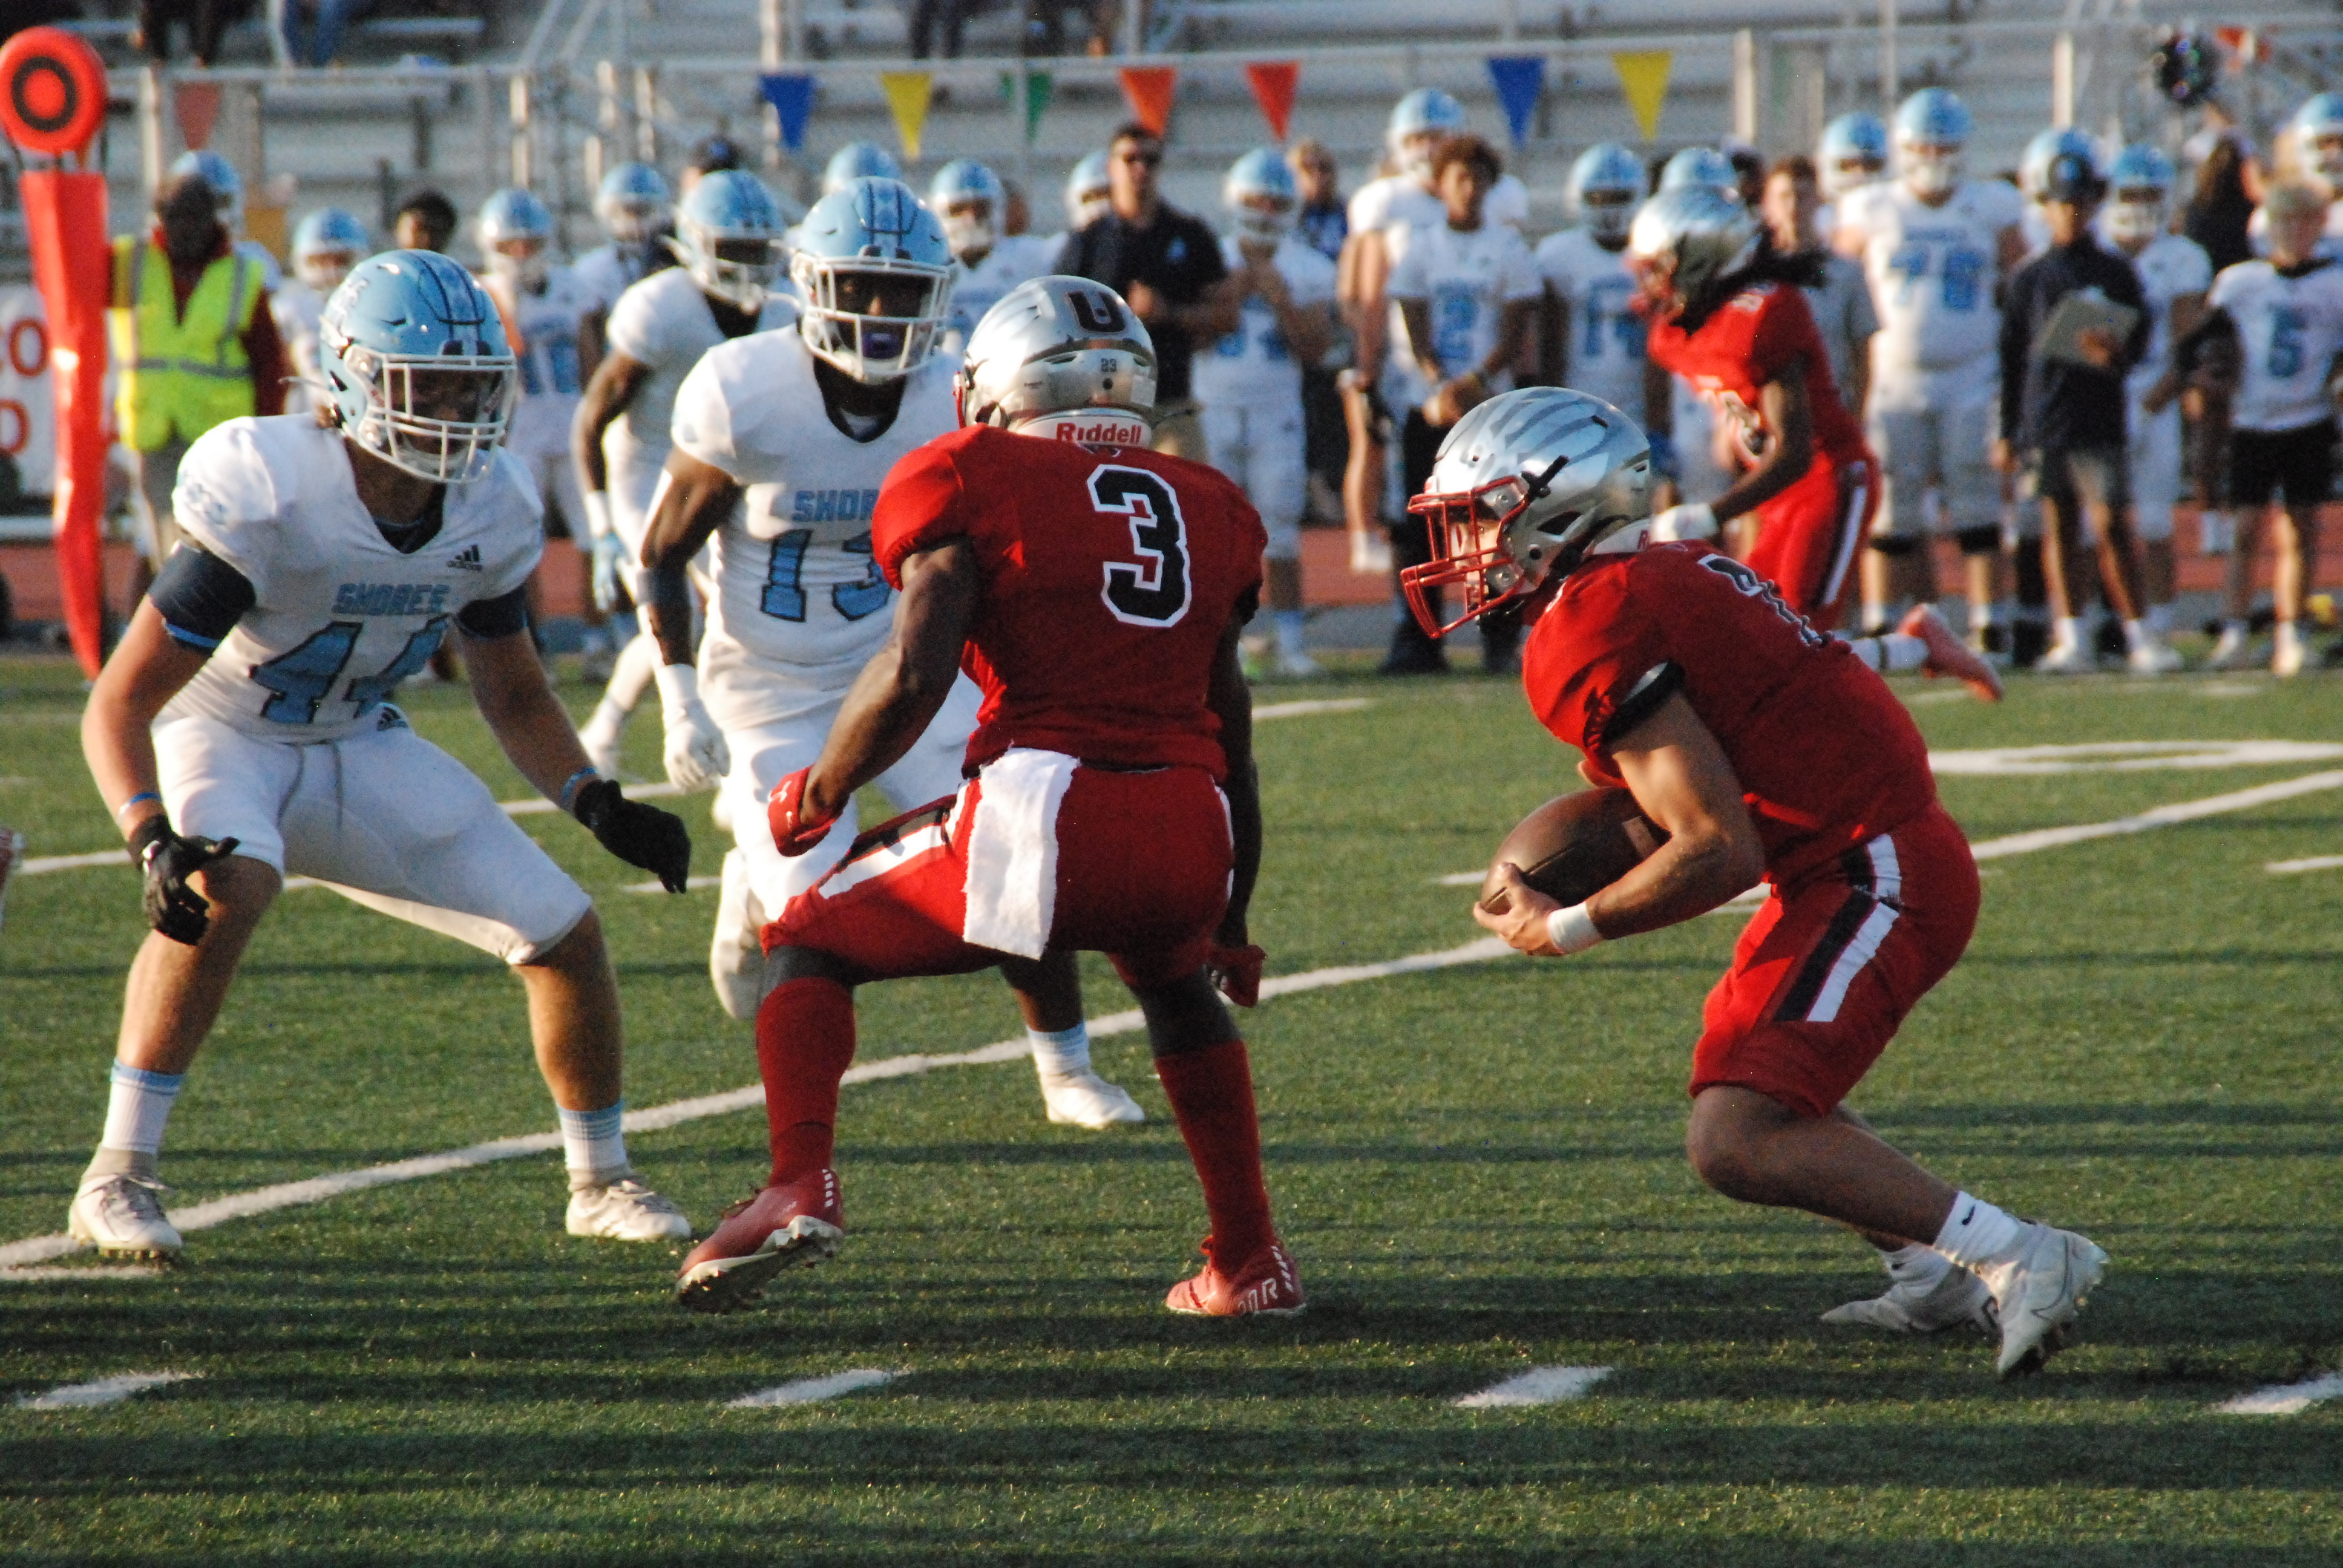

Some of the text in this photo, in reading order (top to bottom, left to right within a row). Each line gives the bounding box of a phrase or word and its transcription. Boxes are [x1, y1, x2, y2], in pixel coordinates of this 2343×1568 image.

[1067, 291, 1126, 333] U
[1057, 422, 1142, 444] Riddell
[1086, 463, 1192, 627] 3
[249, 613, 450, 724] 44
